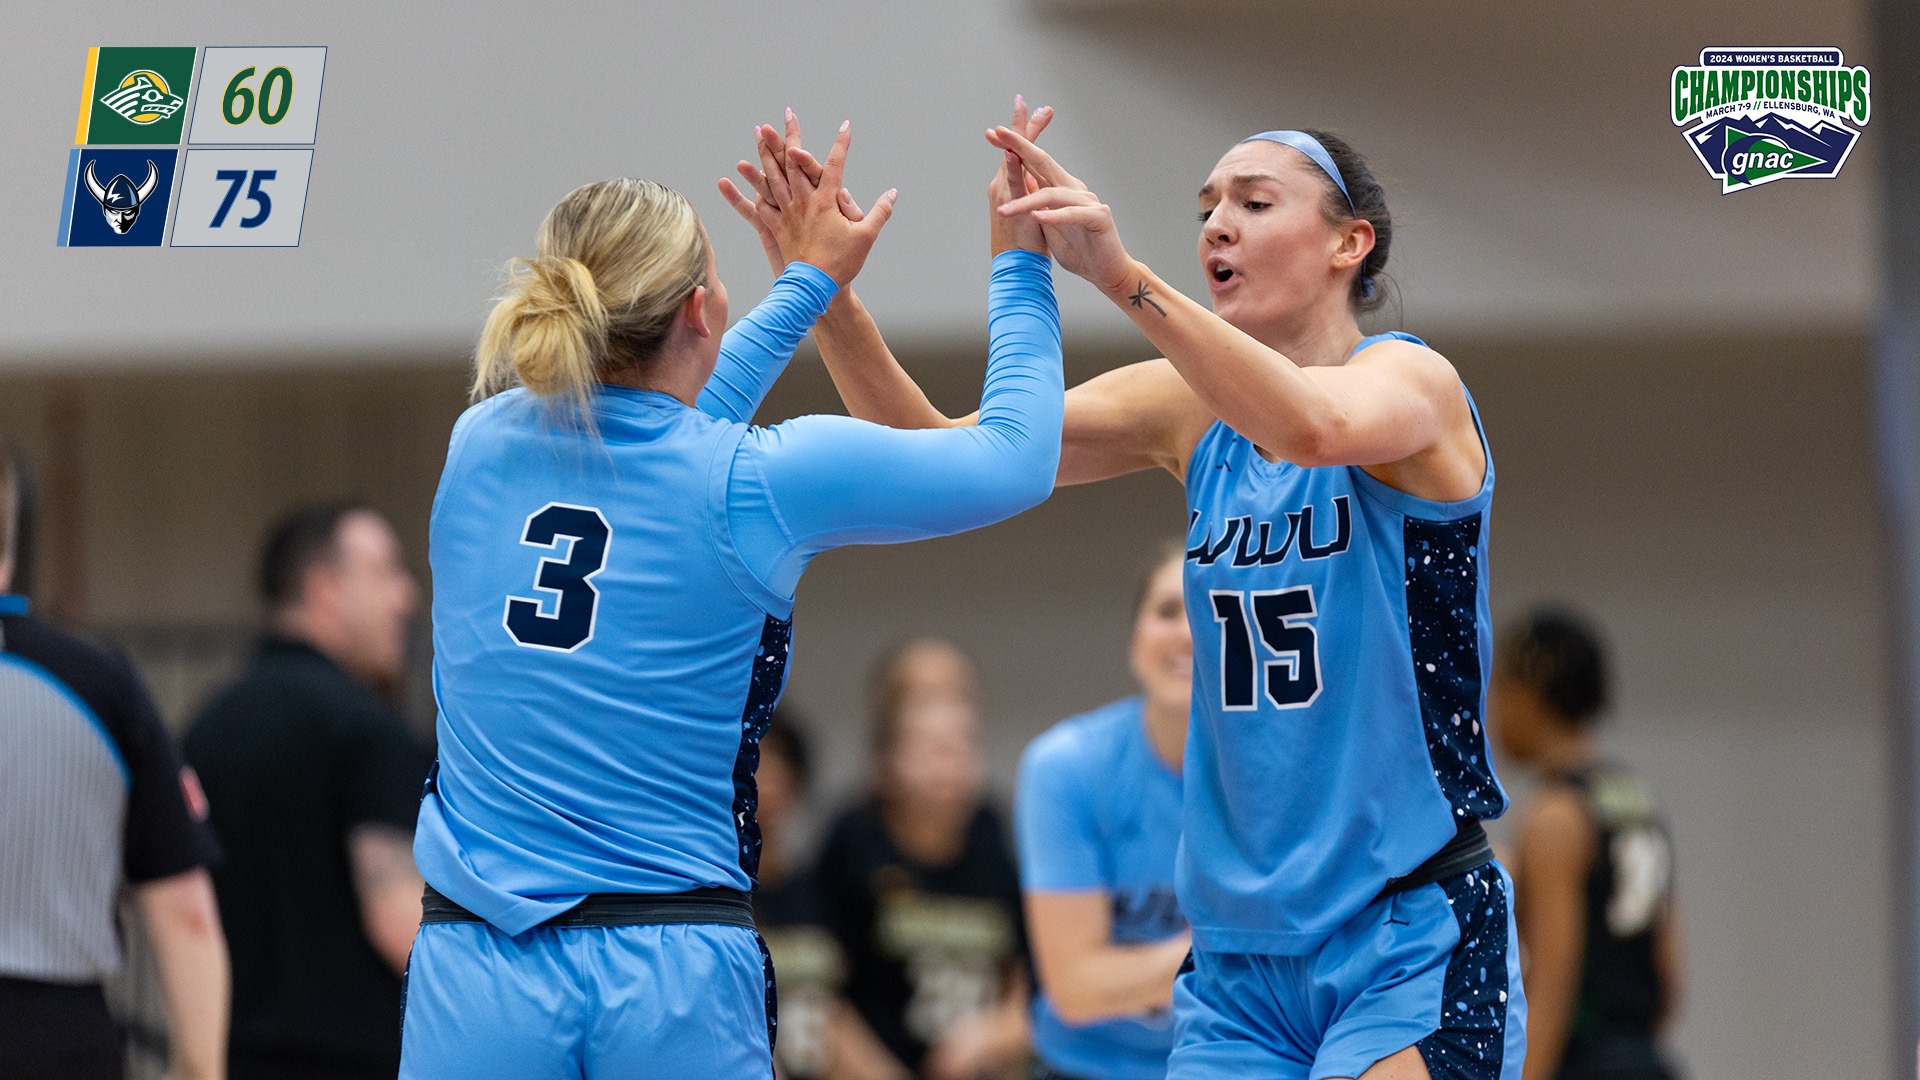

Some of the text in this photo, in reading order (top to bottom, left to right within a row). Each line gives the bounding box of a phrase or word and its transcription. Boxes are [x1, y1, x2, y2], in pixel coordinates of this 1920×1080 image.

[501, 501, 613, 654] 3
[1187, 495, 1351, 568] WWU
[1209, 584, 1324, 712] 15
